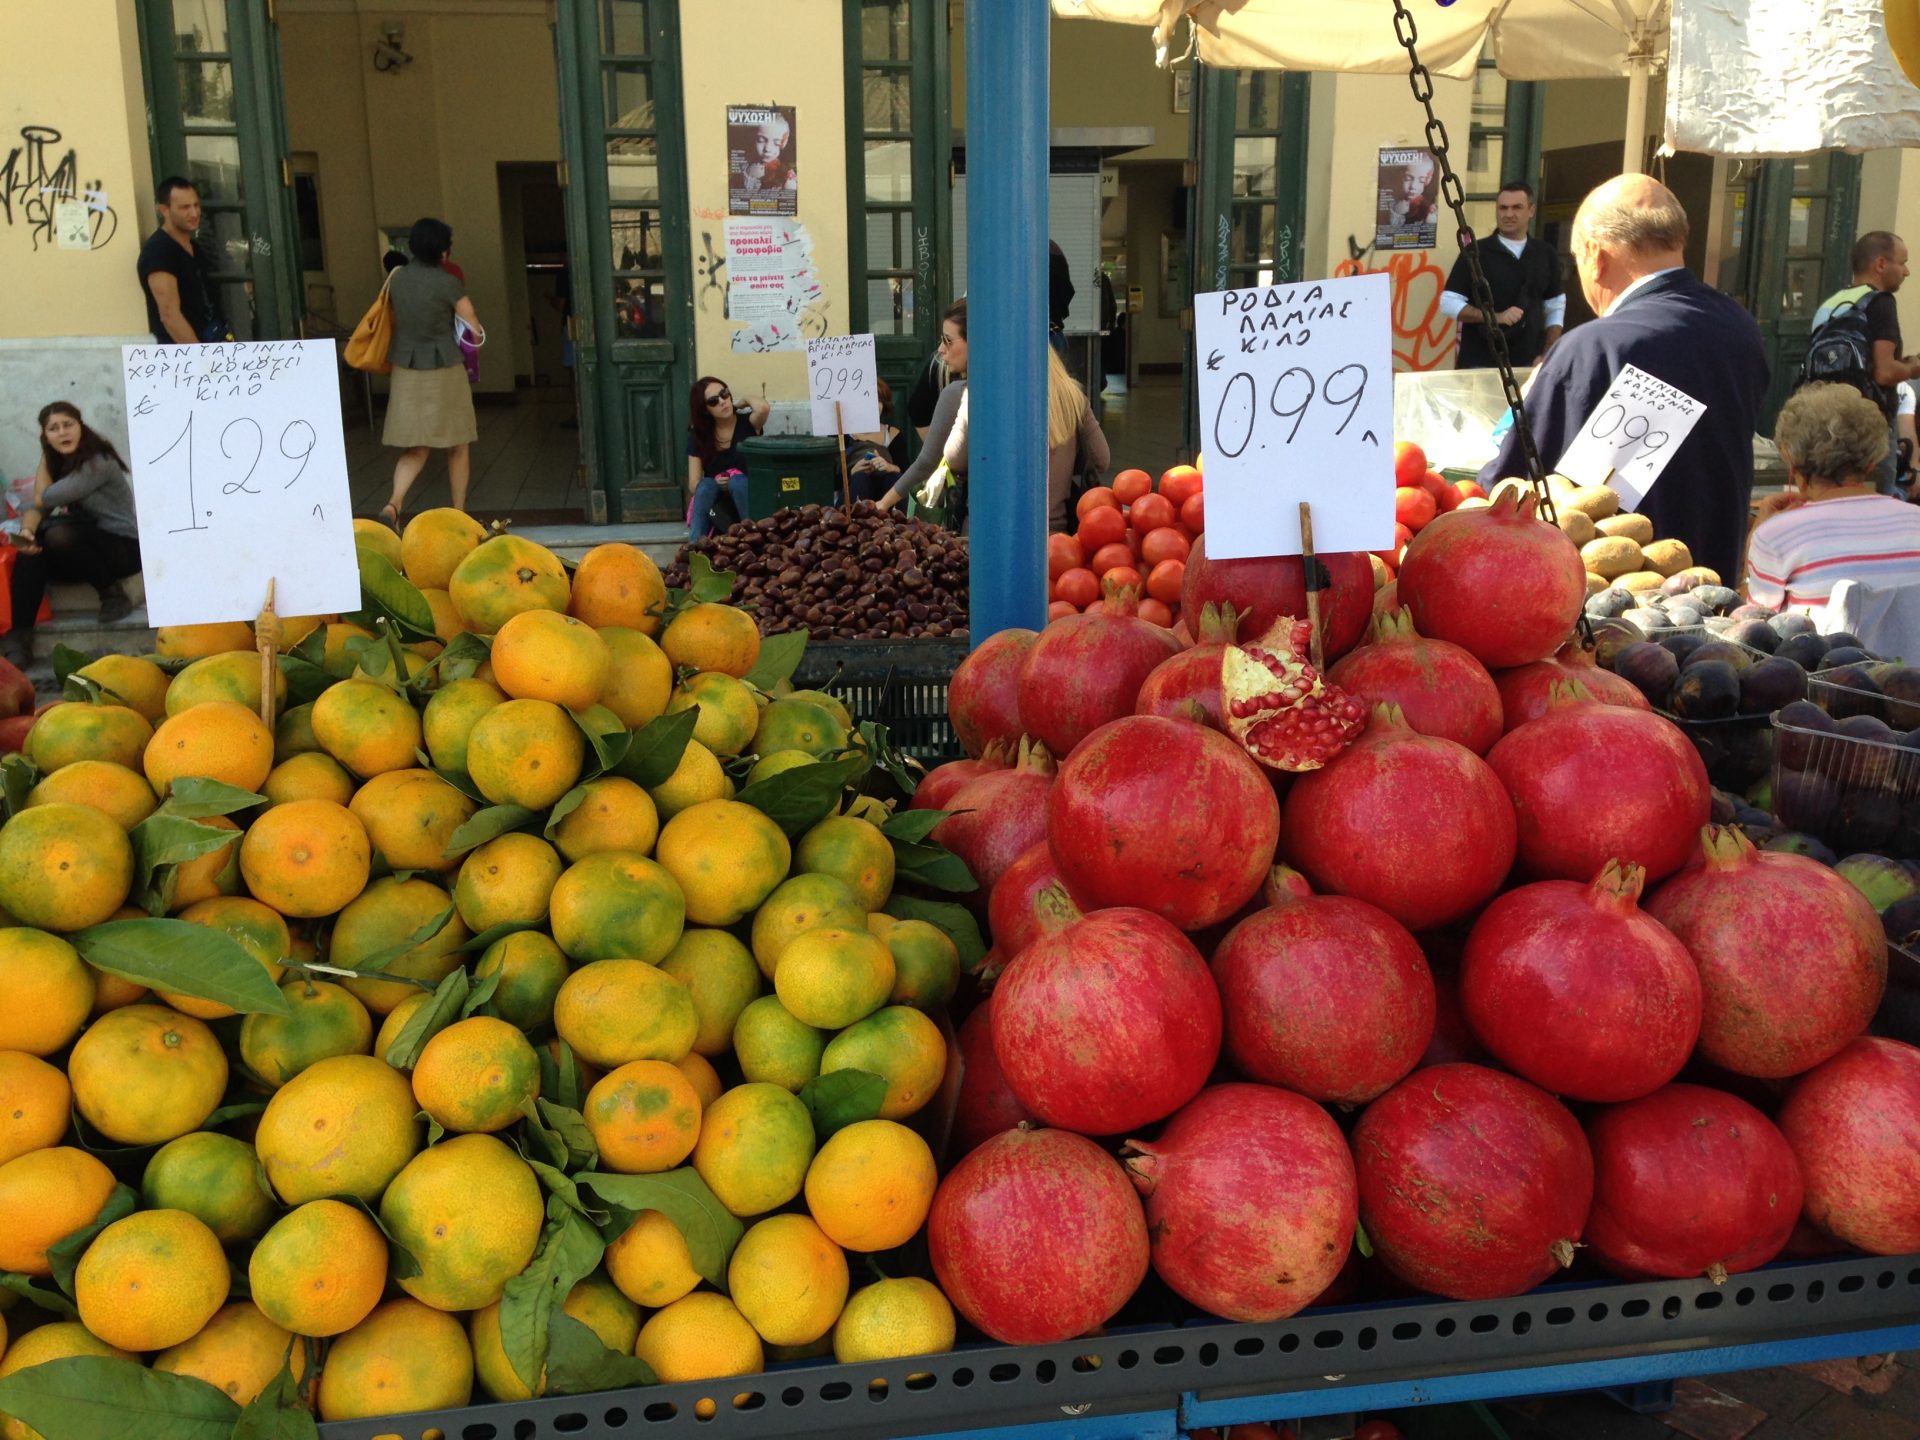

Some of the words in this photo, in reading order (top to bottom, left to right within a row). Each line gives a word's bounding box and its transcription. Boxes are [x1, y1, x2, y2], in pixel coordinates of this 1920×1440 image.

[728, 111, 776, 123] ΨΥΧΩΣΗ!
[1380, 152, 1423, 164] ΨΥΧΩΣΗ!
[730, 236, 772, 246] προκαλεί
[736, 245, 783, 256] ομοφοβία
[732, 274, 747, 282] τότε
[759, 274, 785, 283] μείνετε
[769, 282, 785, 290] σας
[1223, 285, 1323, 315] ΡΟΔΙΑ
[1241, 329, 1311, 353] ΚΙΛΟ
[128, 342, 304, 361] ΜΑΝΤΑΡΙΝΙΑ
[196, 383, 262, 401] ΚΙΛΟ
[1214, 363, 1369, 458] 0.99
[1629, 392, 1665, 411] ΚΙΛΟ
[1591, 404, 1669, 460] 0.99
[149, 410, 316, 534] 1.29
